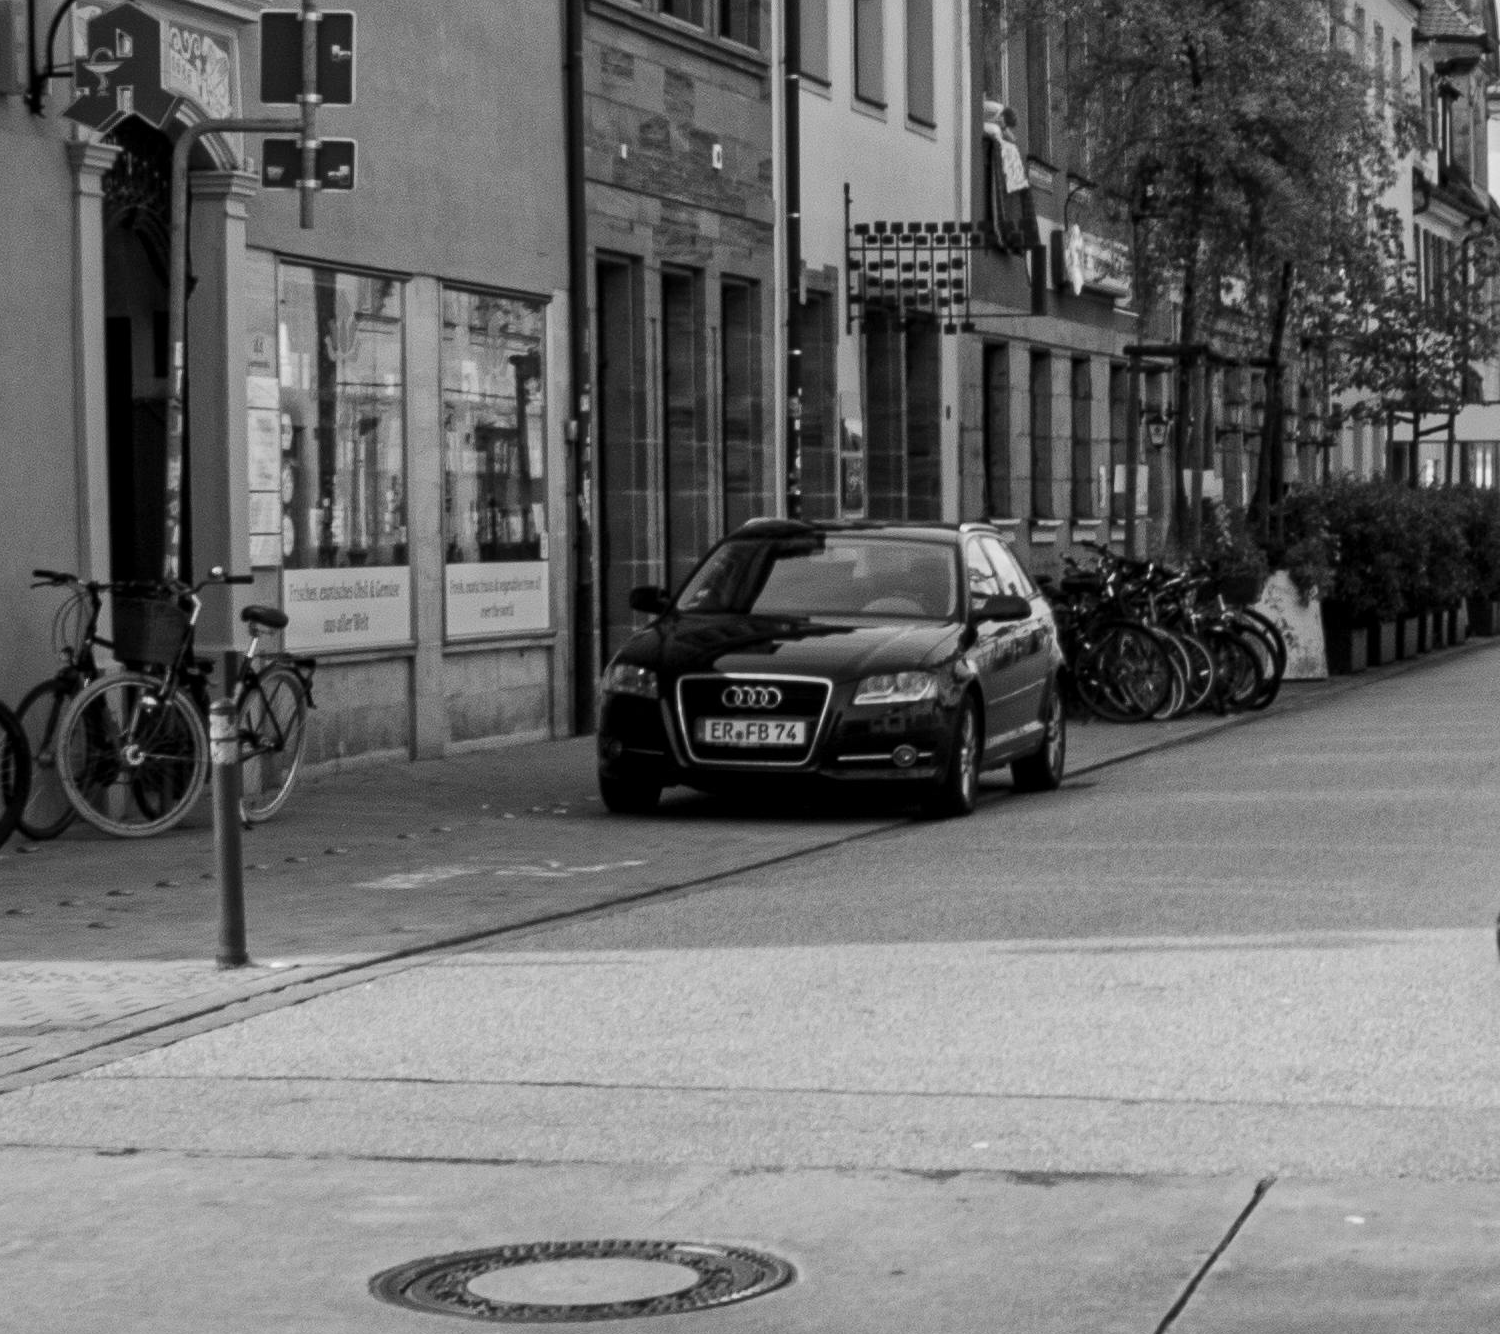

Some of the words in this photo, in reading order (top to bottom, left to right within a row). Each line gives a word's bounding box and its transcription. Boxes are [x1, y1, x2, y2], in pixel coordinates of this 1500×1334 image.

[711, 722, 733, 740] ER
[746, 722, 769, 741] FB
[775, 723, 797, 741] 74
